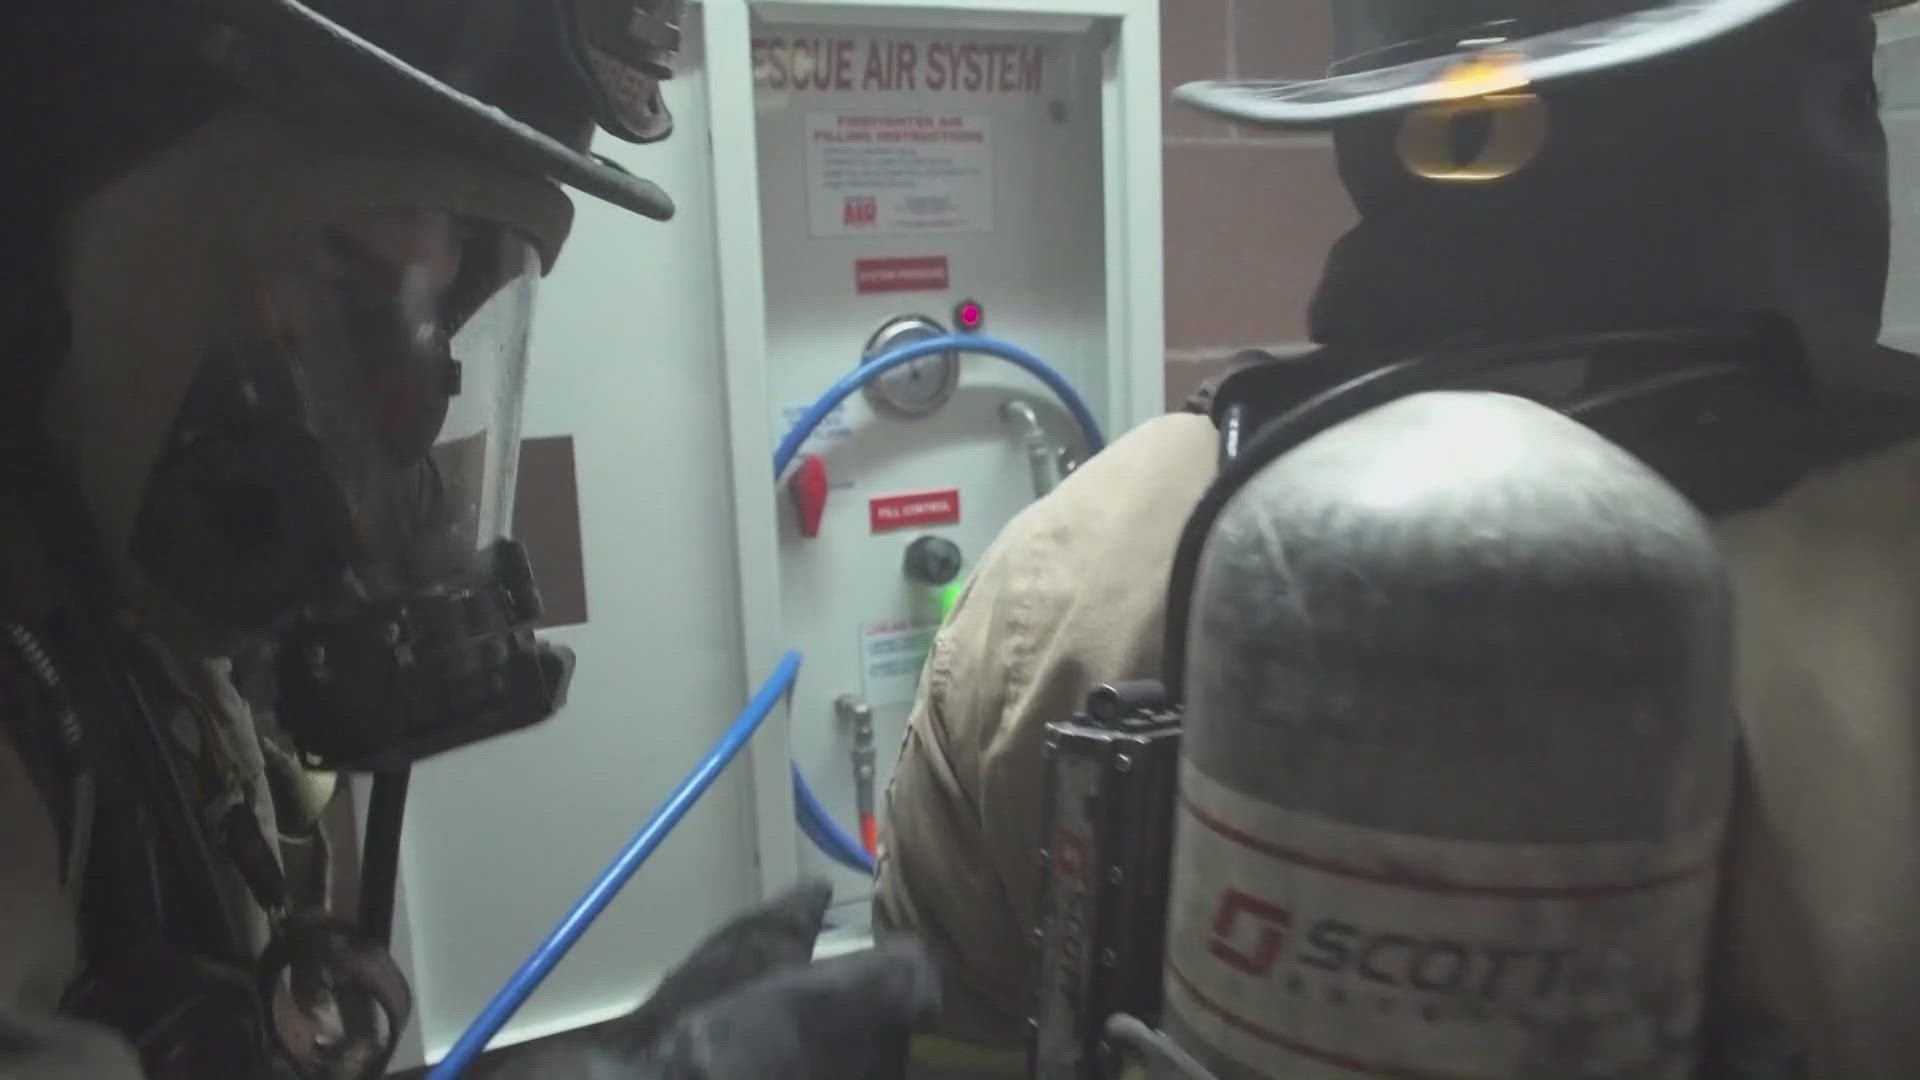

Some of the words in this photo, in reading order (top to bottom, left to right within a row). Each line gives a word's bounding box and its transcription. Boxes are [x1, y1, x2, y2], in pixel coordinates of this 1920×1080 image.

[864, 40, 918, 91] AIR
[926, 41, 1044, 94] SYSTEM
[1297, 918, 1581, 1000] SCOTT
